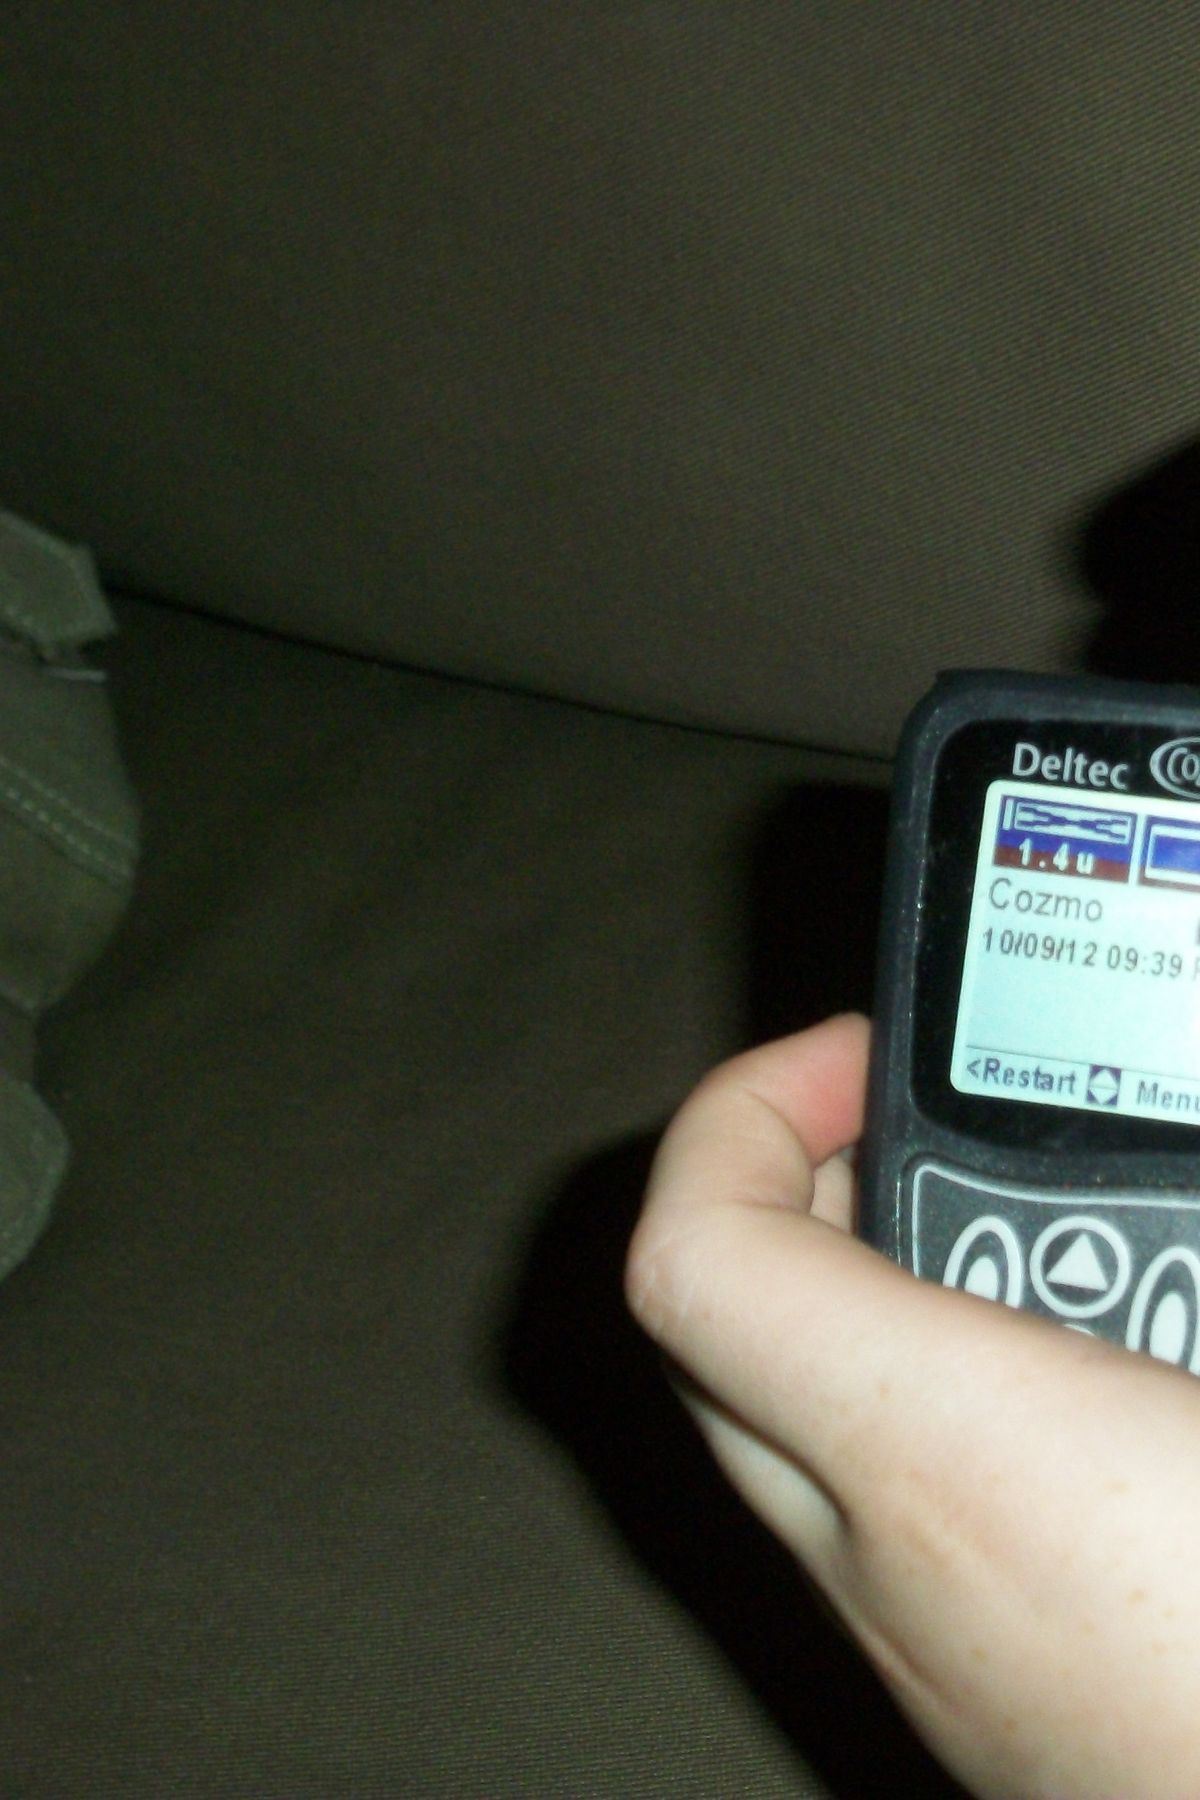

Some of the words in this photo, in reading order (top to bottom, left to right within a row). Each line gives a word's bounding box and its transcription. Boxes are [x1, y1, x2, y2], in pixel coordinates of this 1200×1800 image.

[1012, 742, 1129, 790] Deltec
[988, 877, 1103, 921] Cozmo
[982, 927, 1097, 967] 10/09/12
[1107, 944, 1183, 979] 09:39
